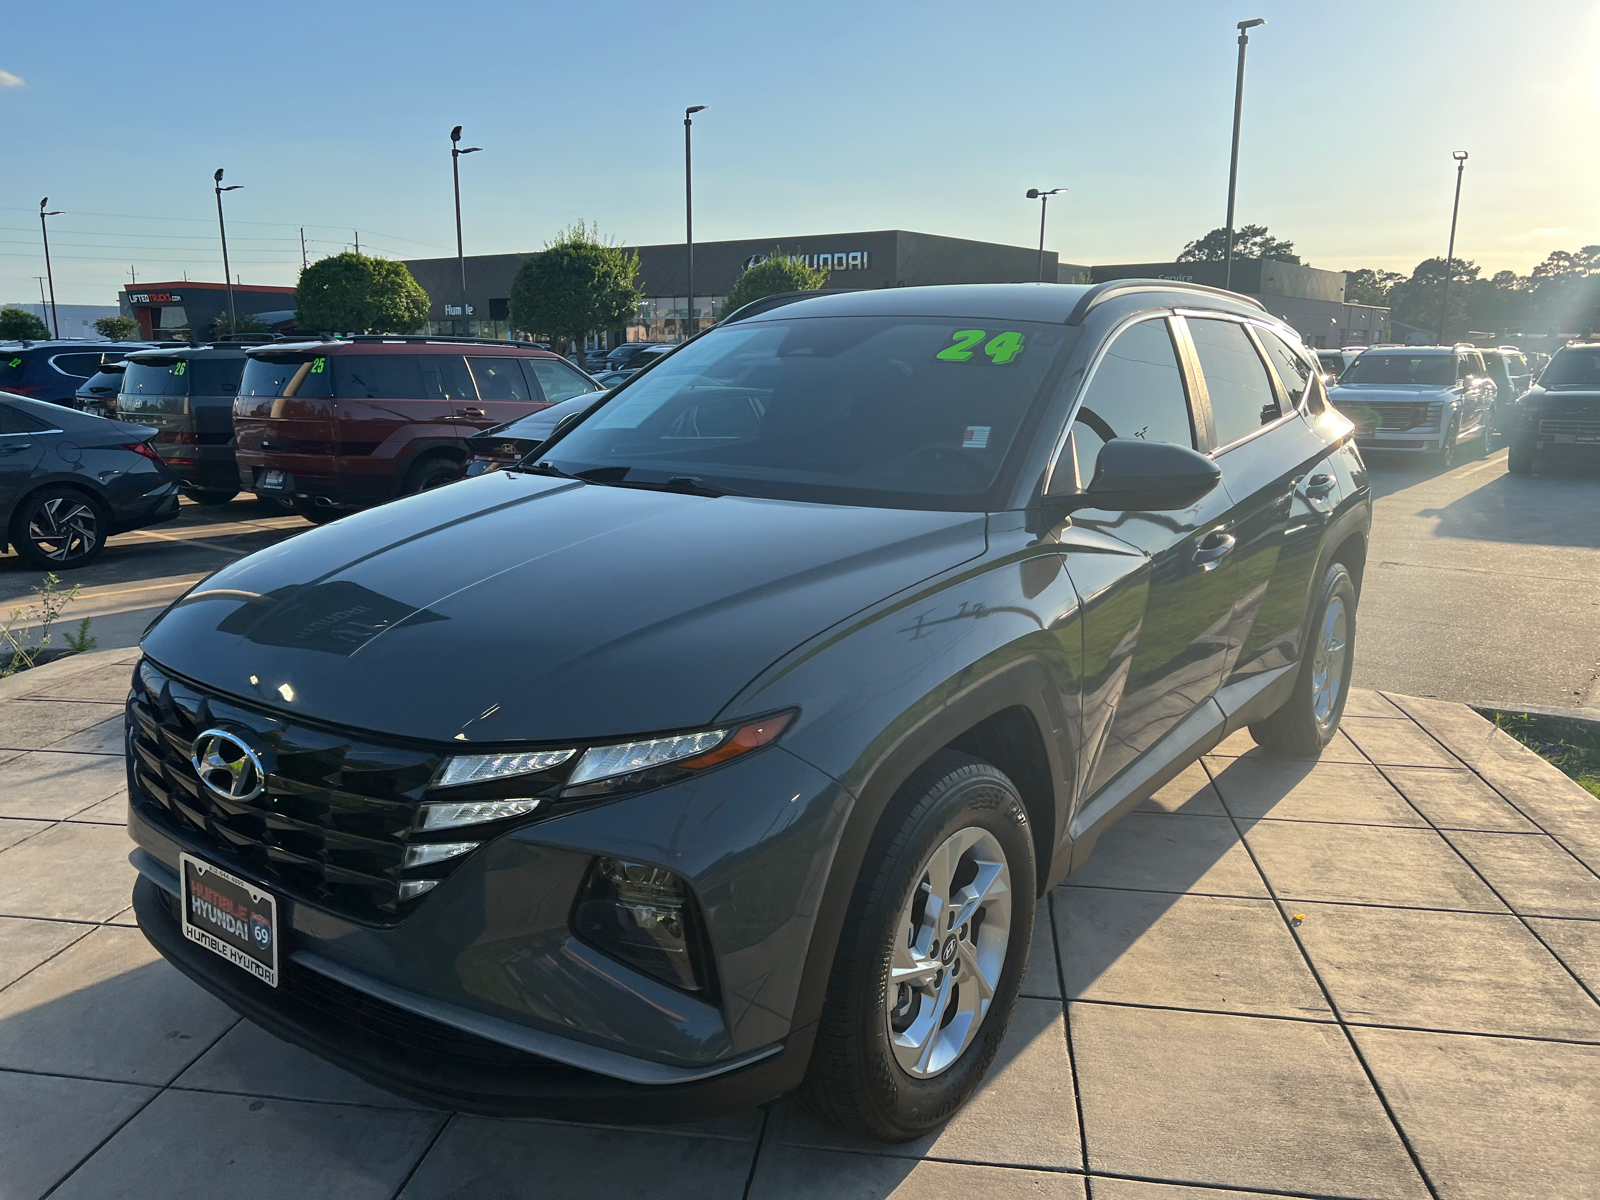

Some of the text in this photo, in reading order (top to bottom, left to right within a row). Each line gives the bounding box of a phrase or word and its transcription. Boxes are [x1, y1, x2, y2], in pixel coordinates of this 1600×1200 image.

[780, 251, 868, 271] YUNDAI
[444, 303, 475, 316] Humle
[936, 329, 1024, 364] 24
[174, 362, 187, 376] 26
[311, 357, 326, 373] 25
[190, 880, 248, 922] HUMBLE
[191, 895, 249, 941] HYUNDAI
[254, 926, 269, 944] 69
[186, 925, 274, 984] HUMBLE HYUNDAI
